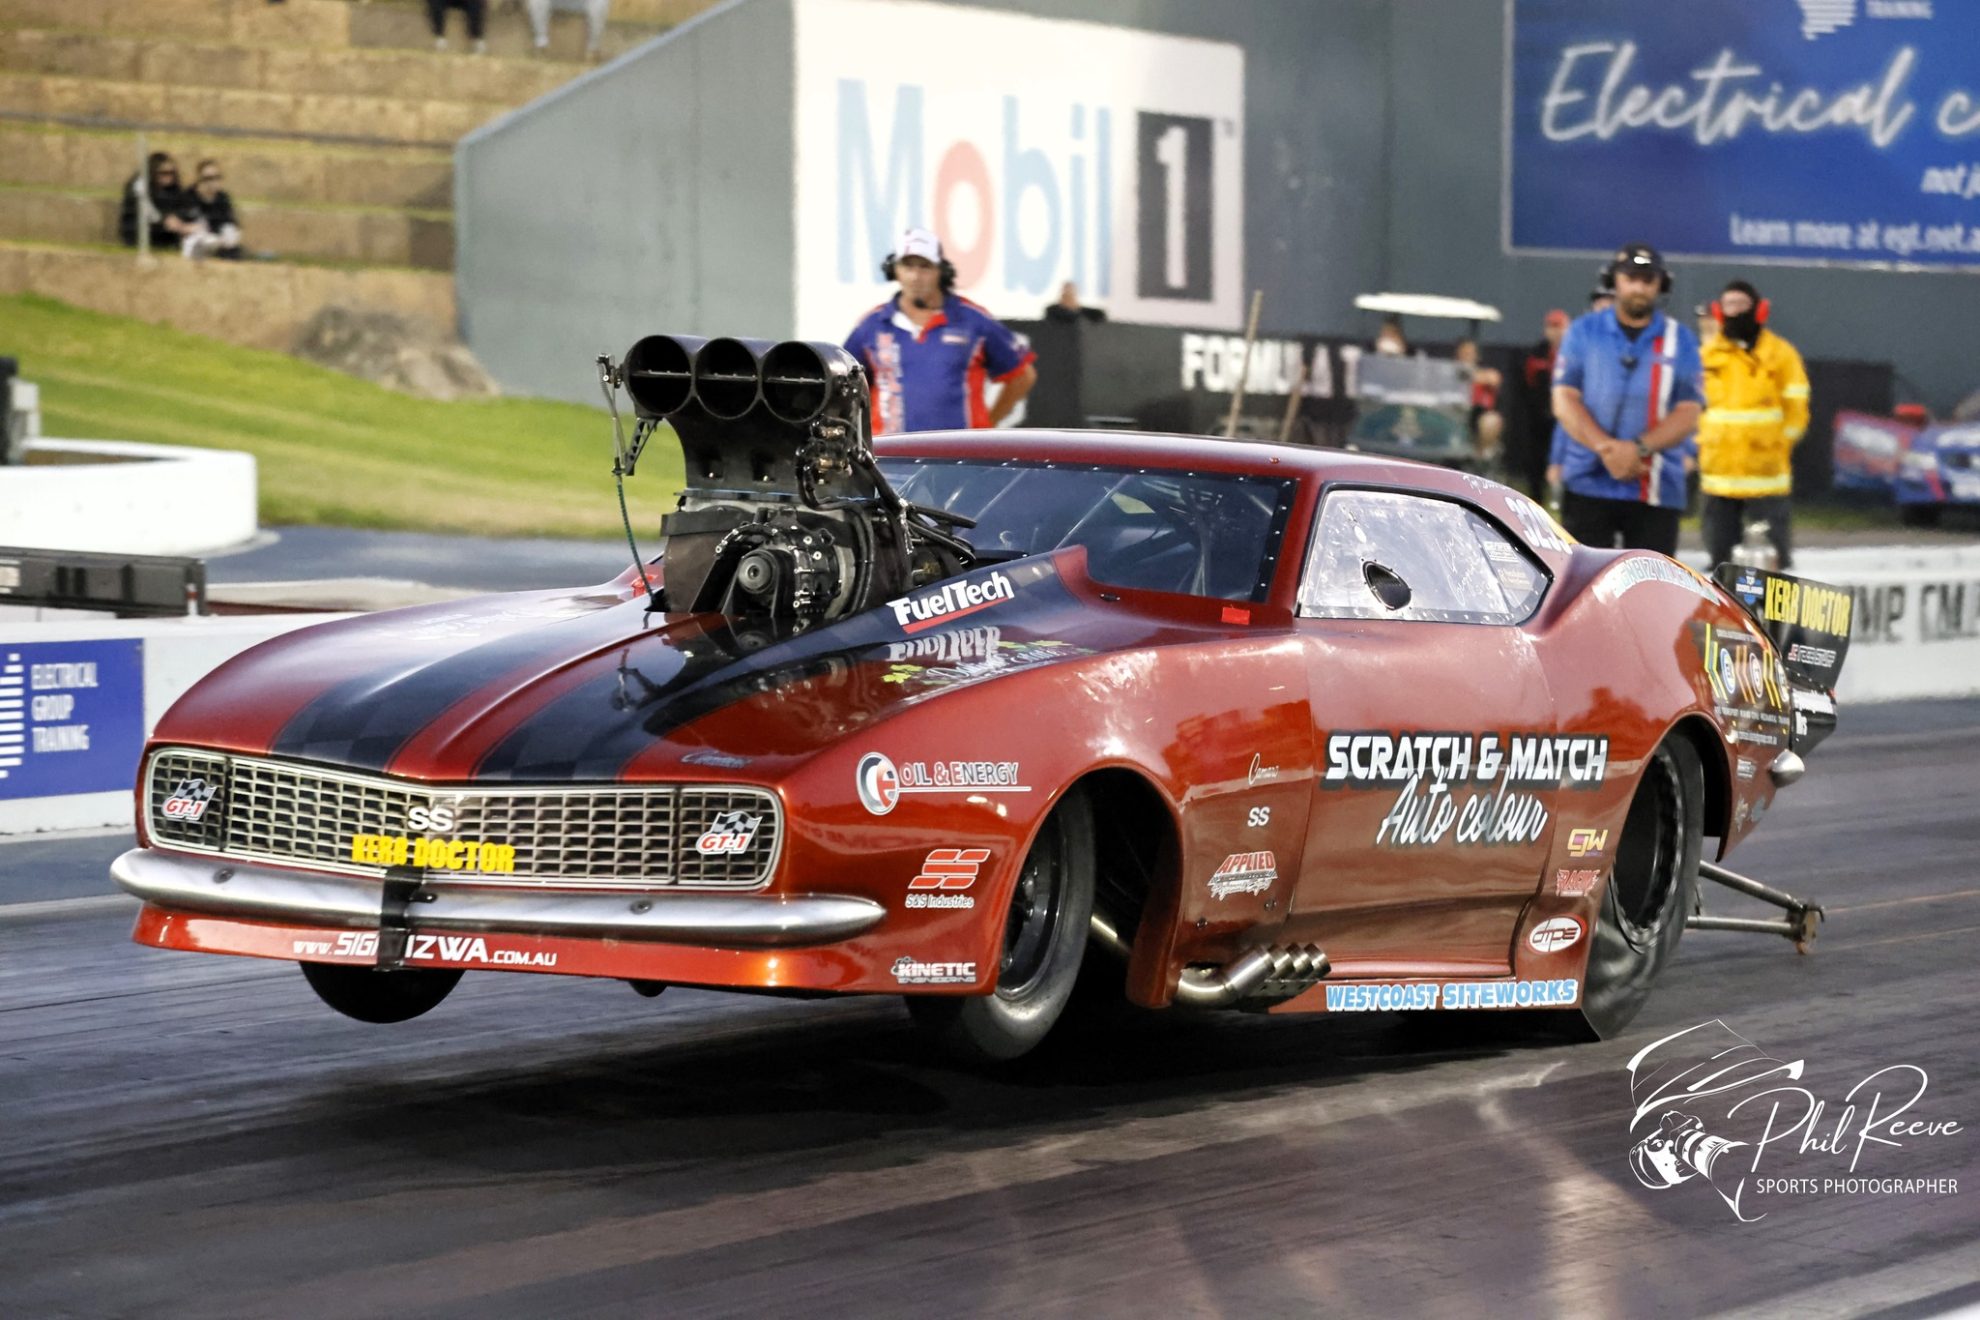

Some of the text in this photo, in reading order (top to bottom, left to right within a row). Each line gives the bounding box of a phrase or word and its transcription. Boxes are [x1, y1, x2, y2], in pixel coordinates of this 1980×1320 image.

[1541, 40, 1915, 147] Electrical
[835, 77, 1112, 298] Mobil
[1730, 213, 1791, 246] Learn
[1795, 219, 1851, 249] more
[1856, 218, 1879, 249] at
[885, 571, 1015, 626] FuelTech
[1800, 584, 1851, 637] DOCTOR
[900, 761, 1018, 786] OIL & ENERGY
[1326, 735, 1608, 781] SCRATCH & MATCH
[165, 798, 204, 817] GT-1
[407, 806, 455, 832] SS
[1247, 806, 1270, 827] SS
[1376, 765, 1548, 845] Auto colour
[351, 833, 516, 873] KERB DOCTOR
[699, 834, 748, 850] GT-1
[1216, 851, 1276, 875] APPLIED
[905, 893, 974, 909] S&S Industries
[898, 962, 976, 977] KINETIC
[1326, 980, 1578, 1011] WESTCOAST SITEWORKS
